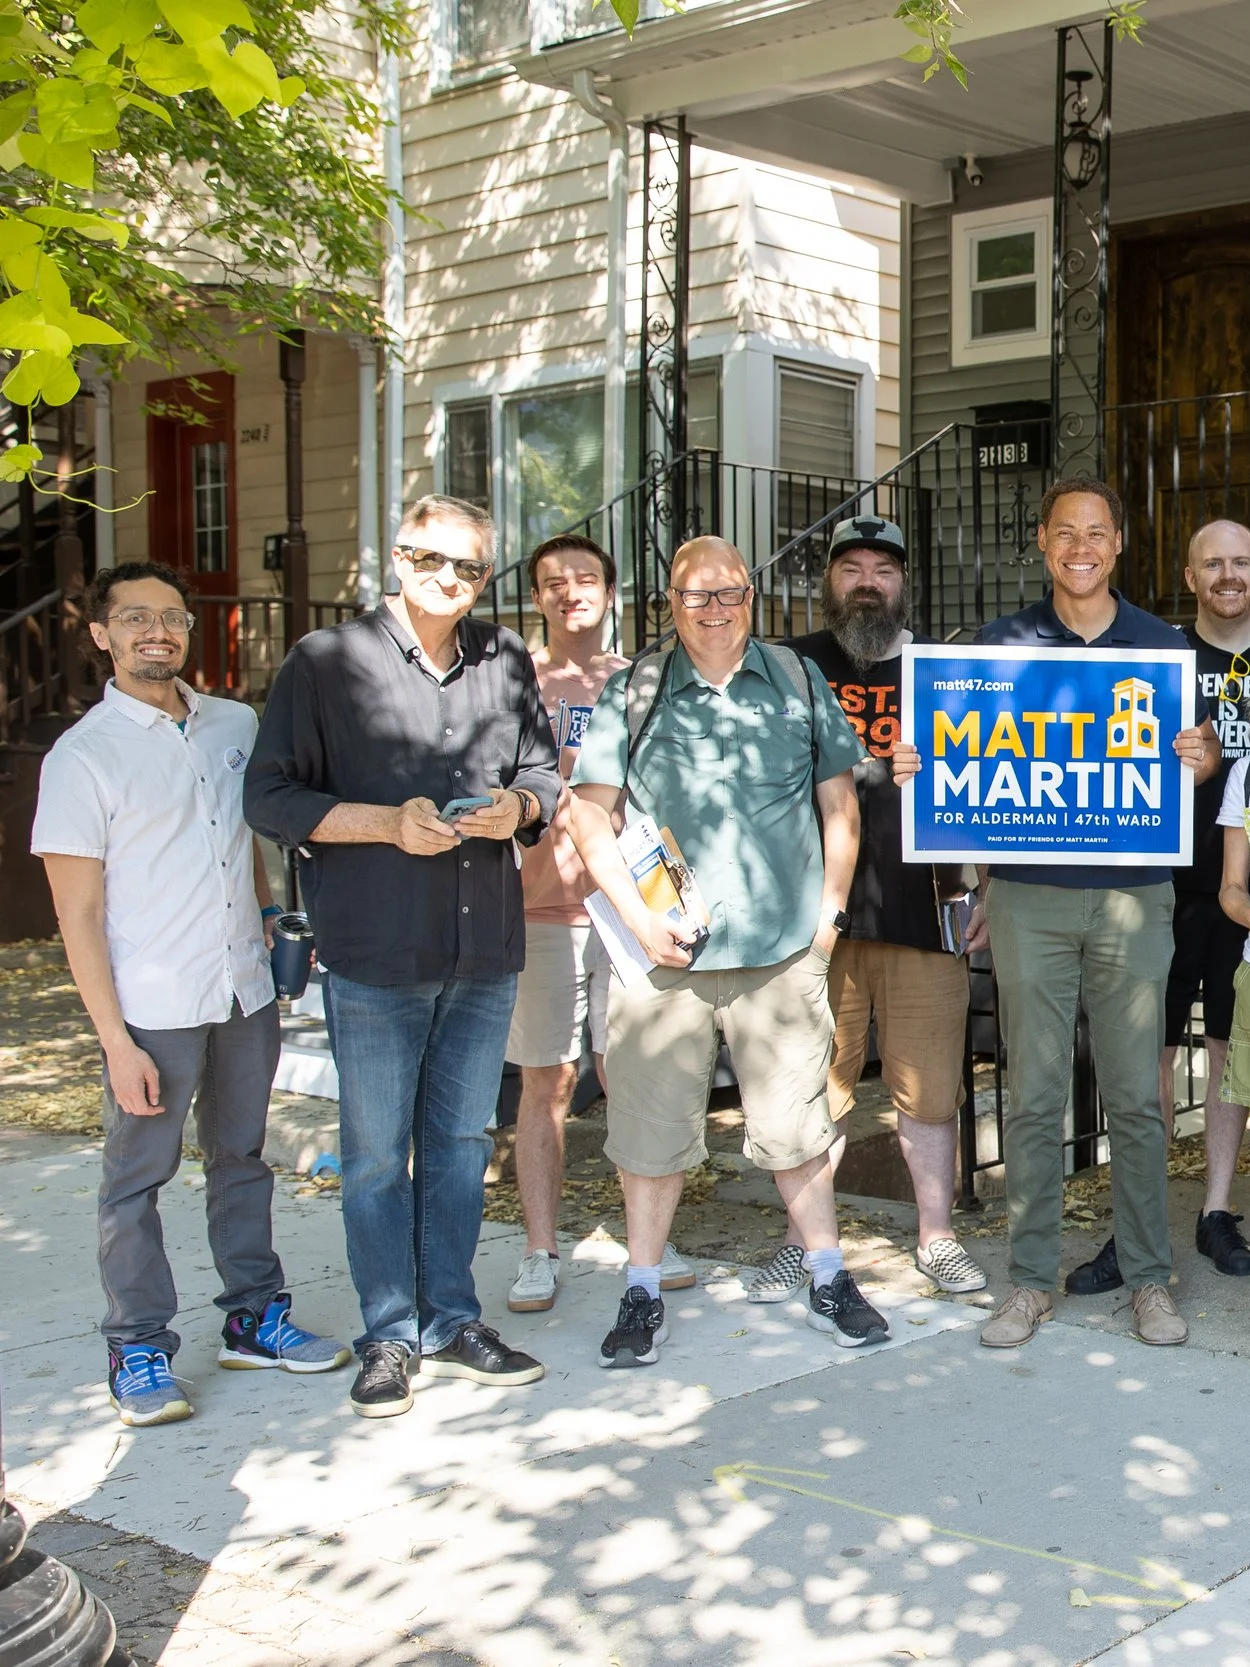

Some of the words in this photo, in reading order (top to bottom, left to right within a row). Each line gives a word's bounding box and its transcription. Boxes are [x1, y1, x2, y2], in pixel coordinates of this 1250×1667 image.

[933, 679, 1014, 692] matt47.com
[1218, 700, 1238, 720] IS
[933, 710, 1095, 758] MATT
[1225, 749, 1244, 758] WANT
[933, 760, 1161, 808] MARTIN
[934, 812, 964, 824] FOR
[971, 812, 1057, 825] ALDERMAN
[1074, 814, 1110, 826] 47th
[1117, 815, 1161, 827] WARD
